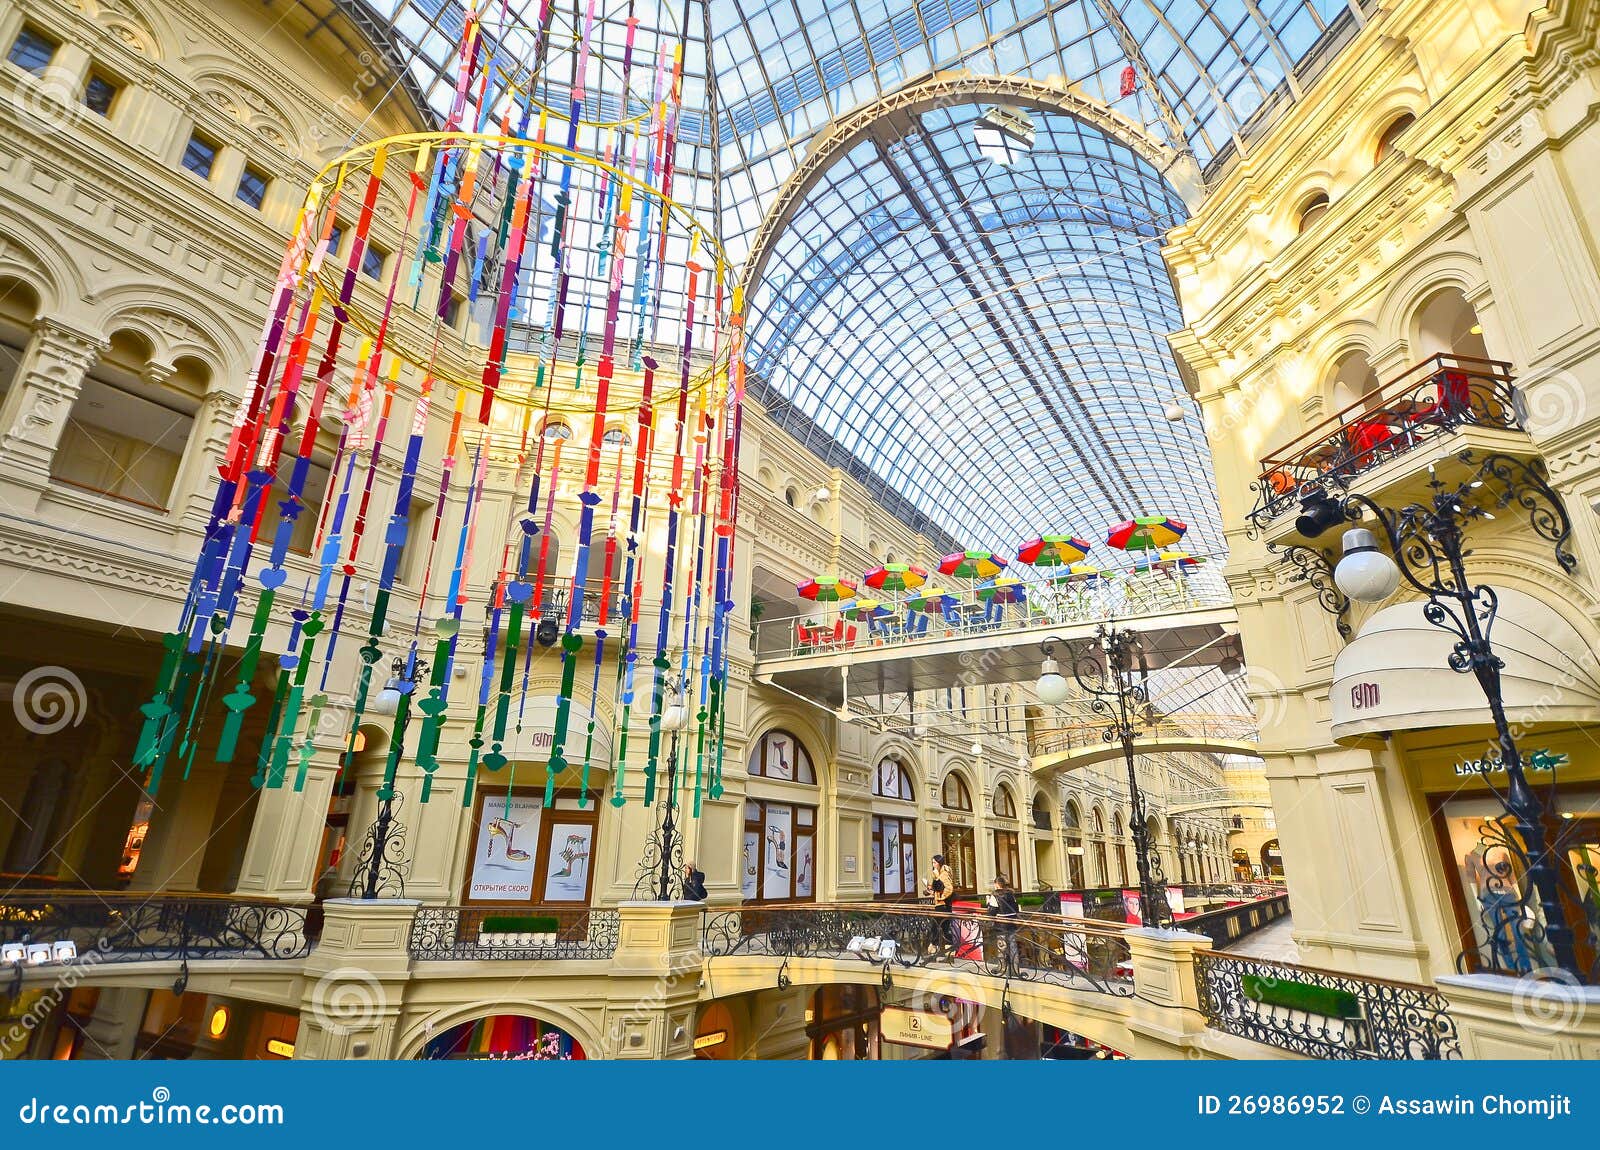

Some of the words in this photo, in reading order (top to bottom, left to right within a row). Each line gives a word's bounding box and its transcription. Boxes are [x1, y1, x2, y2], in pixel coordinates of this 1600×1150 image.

[1453, 757, 1525, 775] LACOS
[473, 884, 507, 892] ОТКРЫТИЕ
[912, 1018, 919, 1029] 2
